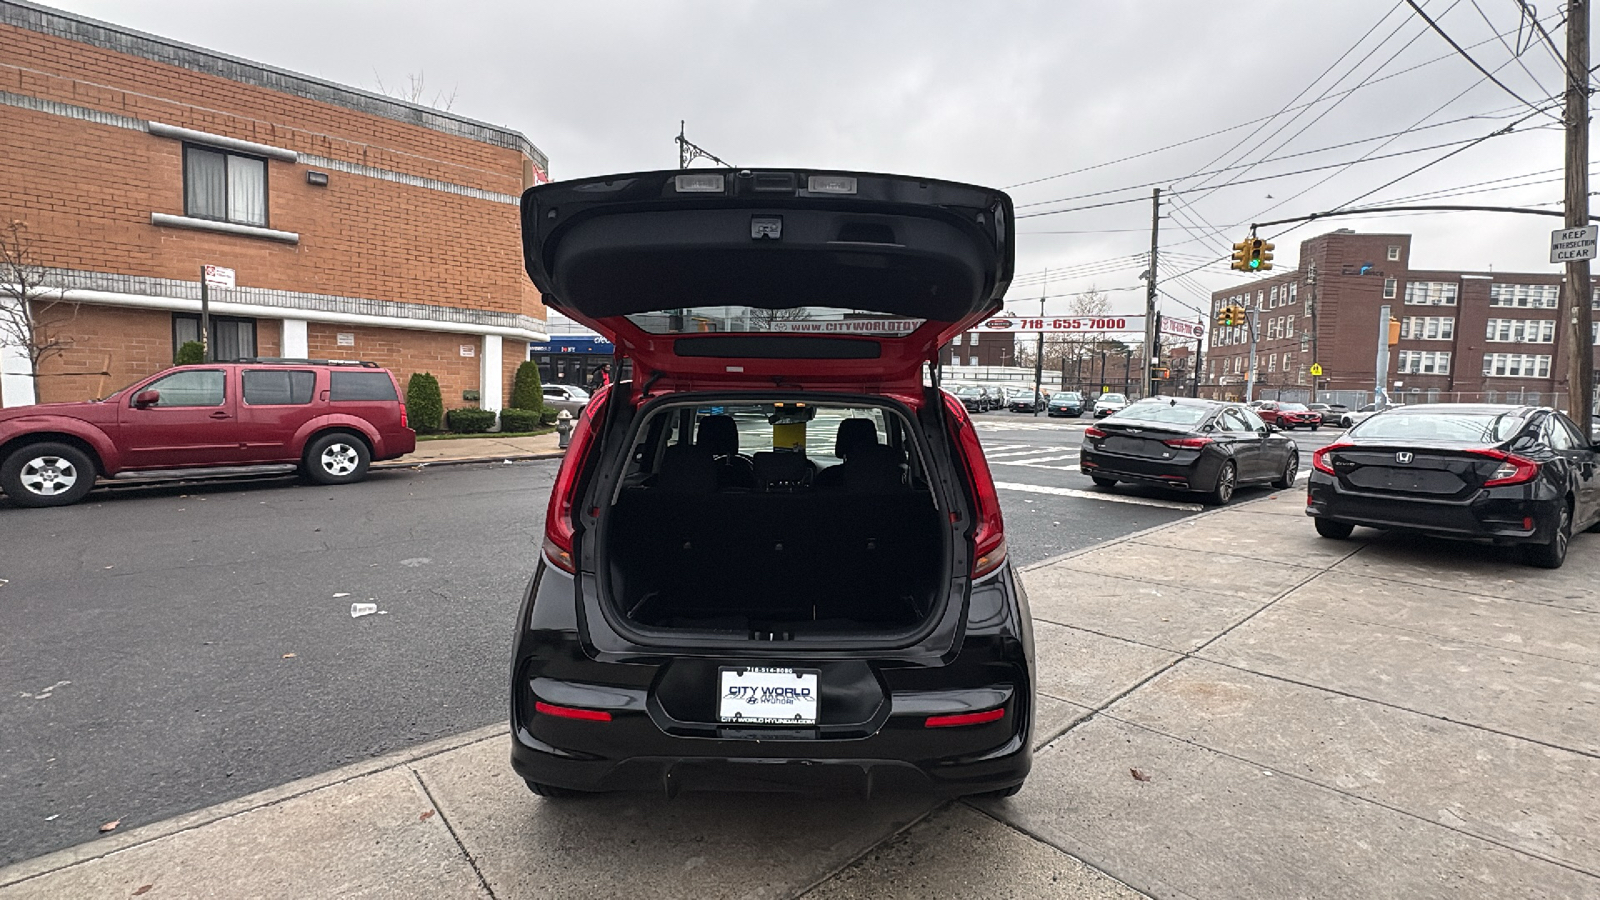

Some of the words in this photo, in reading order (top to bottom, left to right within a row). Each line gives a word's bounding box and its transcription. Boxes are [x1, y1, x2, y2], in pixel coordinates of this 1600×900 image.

[1562, 230, 1586, 240] KEEP
[1553, 240, 1595, 250] INTERSECTION
[1558, 249, 1588, 259] CLEAR
[729, 686, 759, 695] CITY
[761, 686, 811, 696] WORLD
